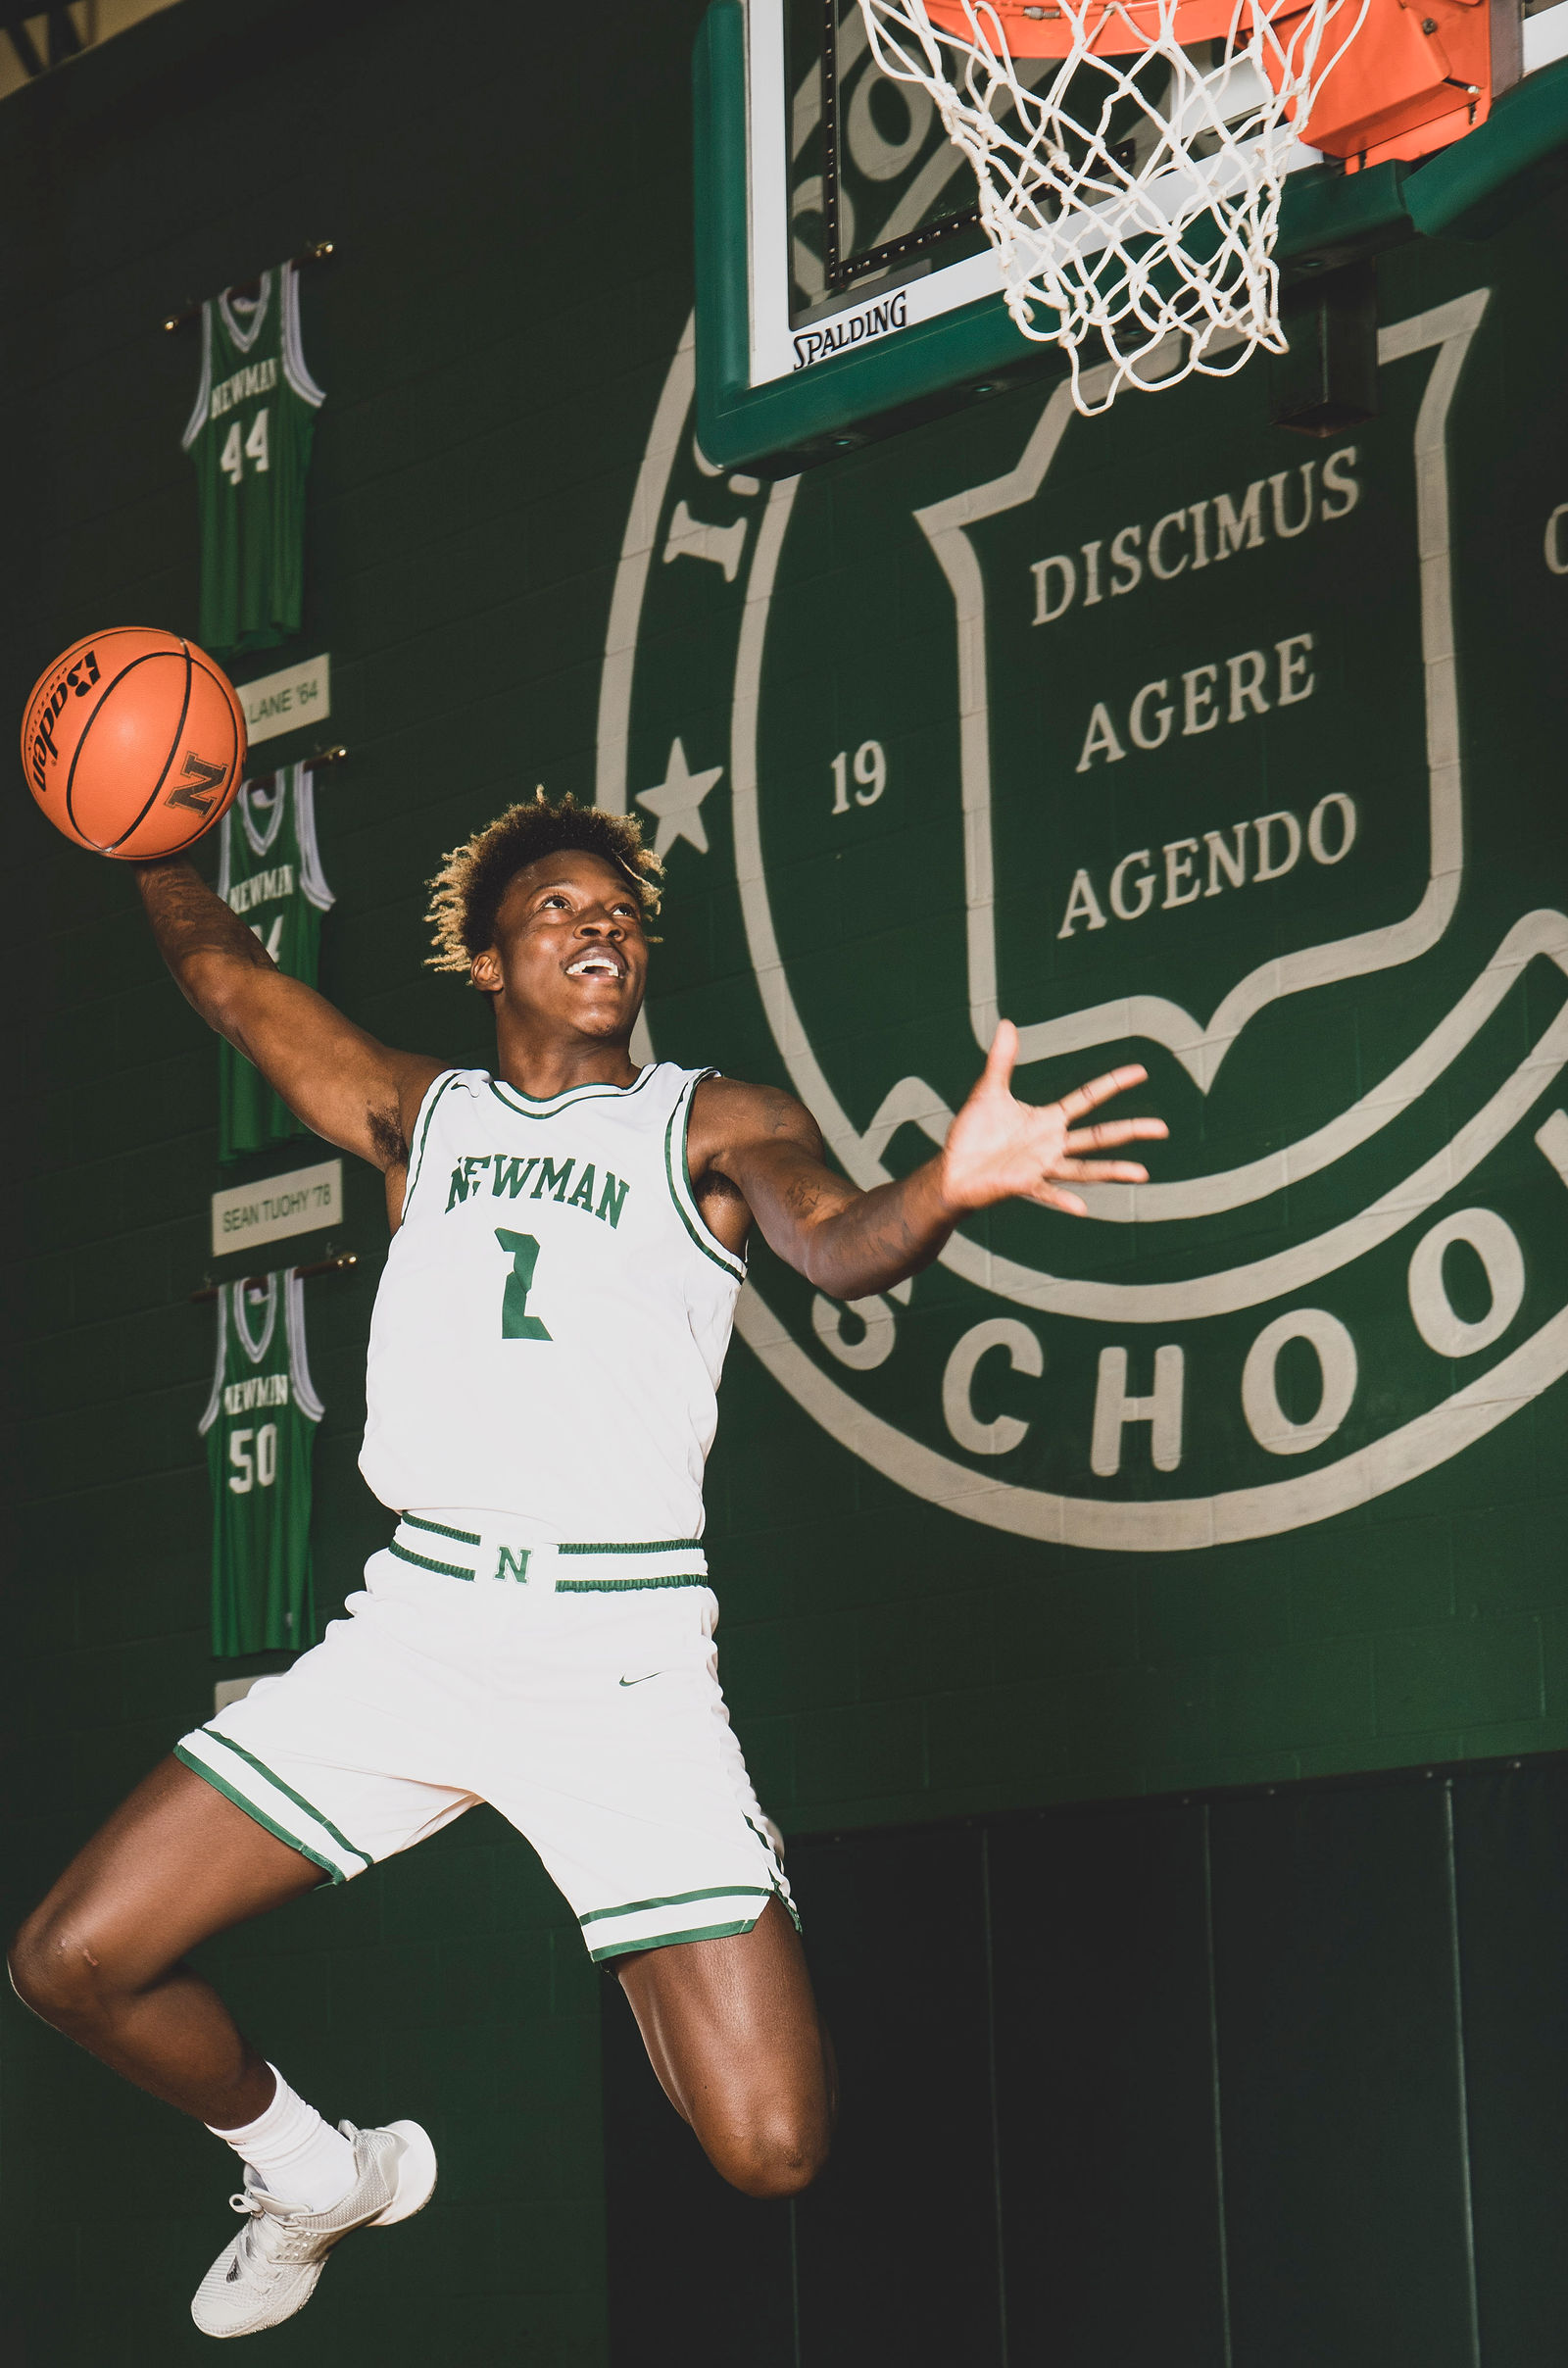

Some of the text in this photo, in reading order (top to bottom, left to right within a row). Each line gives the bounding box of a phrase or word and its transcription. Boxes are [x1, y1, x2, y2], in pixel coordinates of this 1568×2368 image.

[793, 291, 907, 371] SPALDING
[220, 408, 270, 485] 44
[1030, 446, 1363, 626] DISCIMUS
[33, 650, 101, 792] Baden
[248, 688, 292, 724] LANE
[1076, 632, 1316, 773] AGERE
[164, 751, 228, 818] N
[829, 739, 888, 814] 19
[1057, 792, 1358, 940] AGENDO
[222, 1207, 260, 1233] SEAN
[262, 1188, 310, 1222] TUOHY
[444, 1154, 630, 1230] NEWMAN
[494, 1227, 555, 1342] 2
[228, 1422, 278, 1495] 50
[494, 1543, 535, 1588] N
